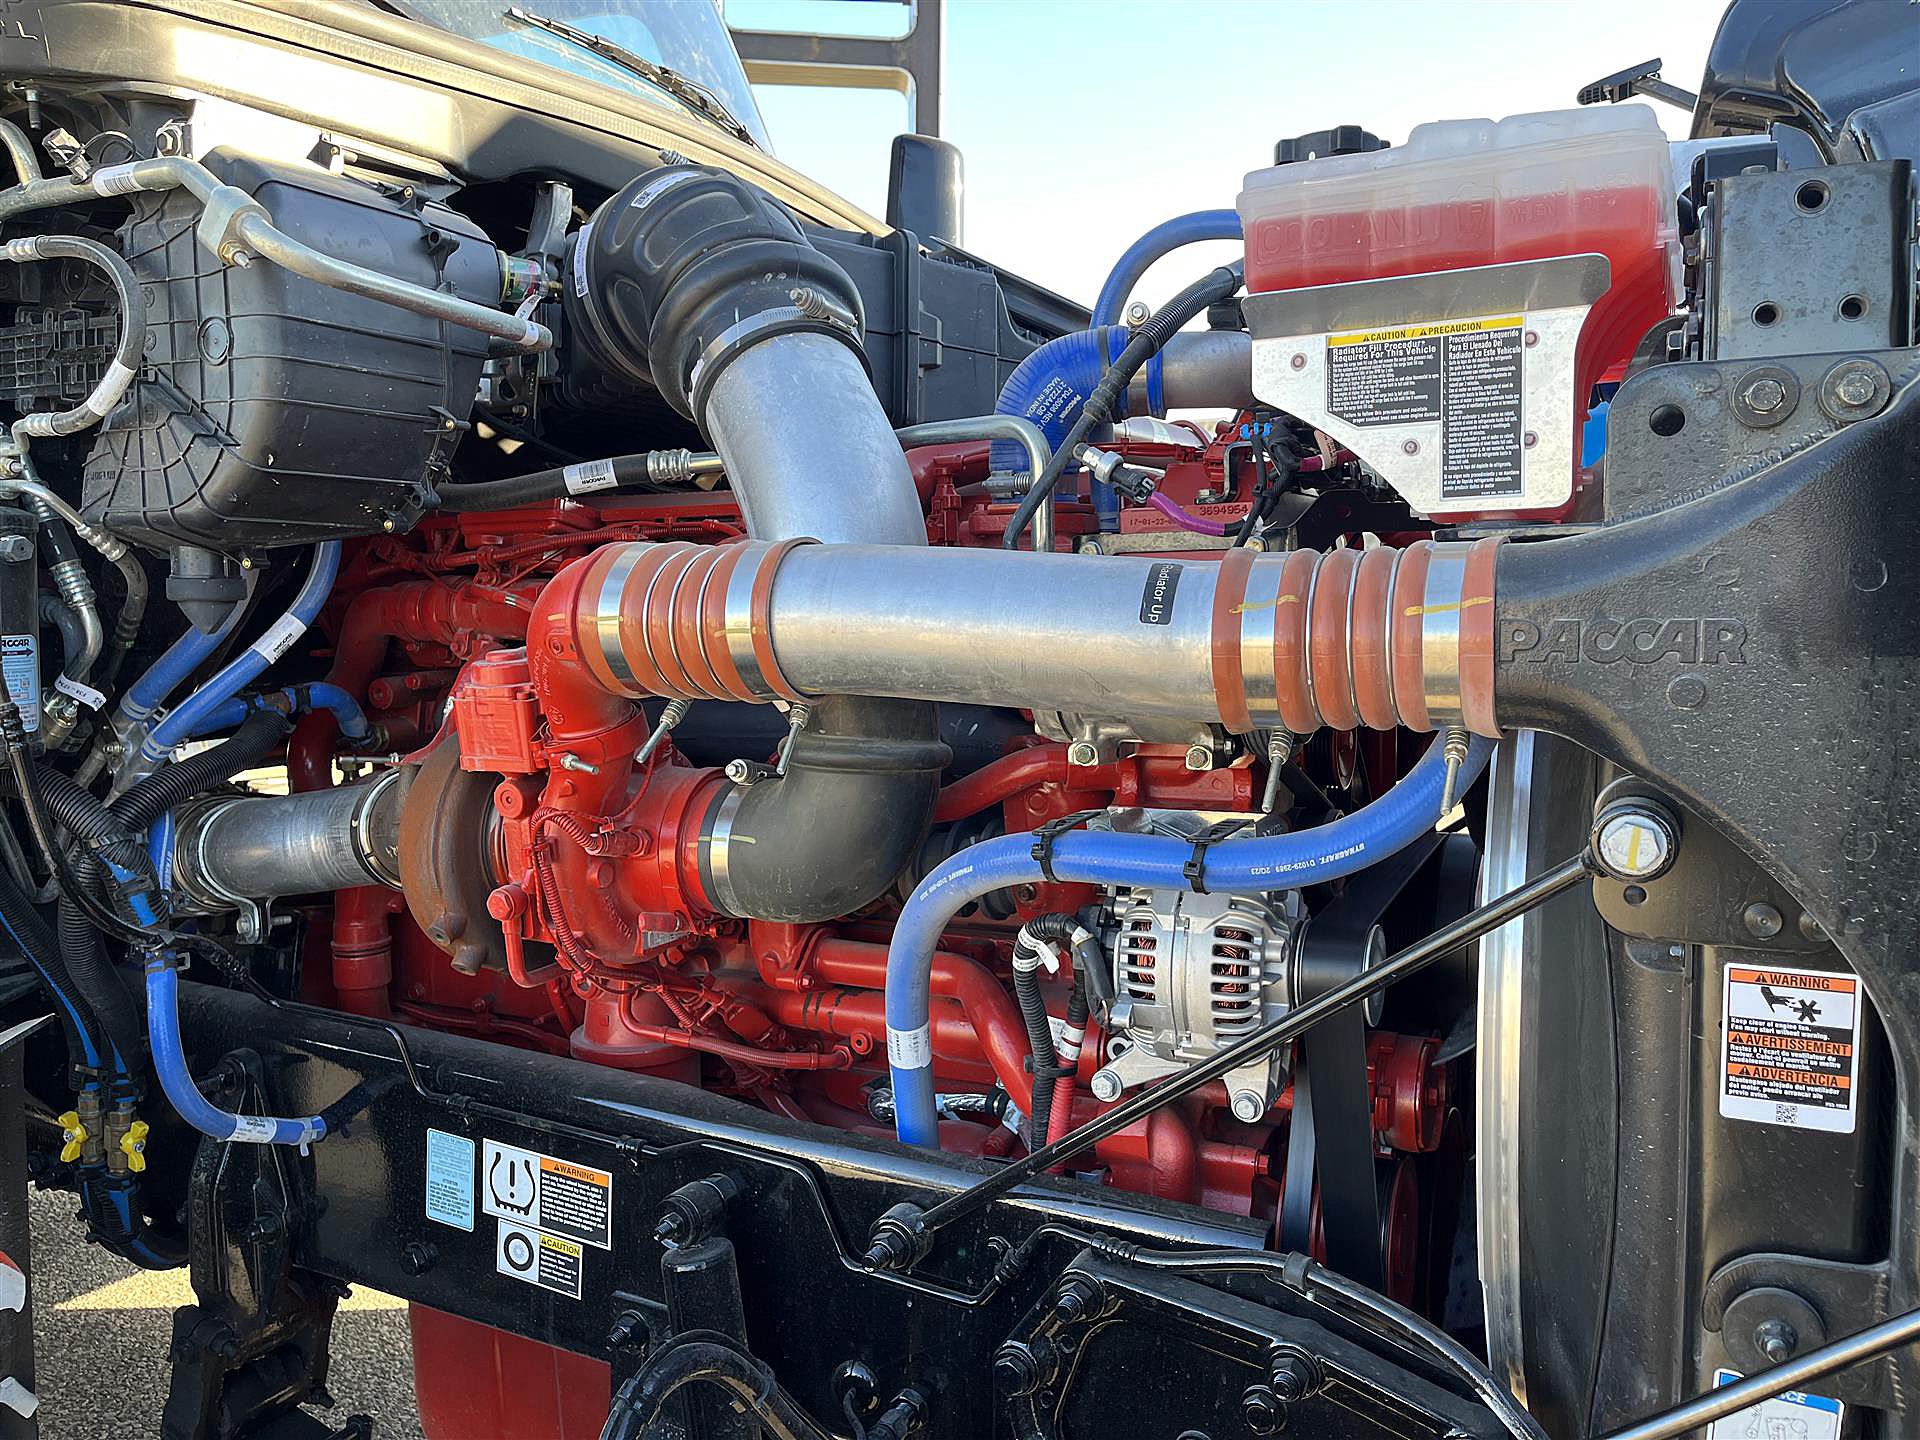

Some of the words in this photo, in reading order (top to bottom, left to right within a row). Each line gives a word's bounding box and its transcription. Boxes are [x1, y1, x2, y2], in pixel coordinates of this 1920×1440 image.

[1261, 205, 1433, 254] COOLANT
[1370, 330, 1406, 342] CAUTION
[1428, 322, 1482, 336] PRECAUCION
[1448, 333, 1489, 344] Procedimiento
[1490, 330, 1520, 340] Requerido
[1333, 346, 1366, 356] Radiator
[1369, 344, 1382, 352] Fill
[1448, 344, 1462, 352] Para
[1462, 342, 1469, 350] El
[1470, 340, 1492, 349] Llenado
[1492, 338, 1503, 348] Del
[1333, 352, 1369, 363] Required
[1387, 348, 1404, 358] This
[1406, 344, 1436, 354] Vehicle
[1448, 351, 1474, 360] Radiador
[1474, 350, 1482, 358] En
[1483, 348, 1496, 356] Este
[1043, 376, 1060, 395] MADE
[1024, 400, 1040, 418] INDIA
[1040, 412, 1053, 426] REV
[1154, 564, 1174, 602] Radiator
[1148, 604, 1164, 622] Up
[2, 638, 30, 648] ACCAR
[1499, 618, 1747, 664] PACCAR
[1770, 974, 1830, 990] WARNING
[1731, 1017, 1747, 1026] Keep
[1748, 1019, 1765, 1027] clear
[1775, 1022, 1797, 1030] engine
[1798, 1024, 1812, 1032] fan.
[1759, 1026, 1775, 1034] start
[1776, 1028, 1800, 1038] without
[1801, 1030, 1831, 1041] warning.
[1746, 1034, 1849, 1055] AVERTISSEMENT
[1753, 1068, 1838, 1086] ADVERTENCIA
[1728, 1088, 1749, 1096] previo
[1750, 1091, 1770, 1100] aviso.
[560, 1165, 595, 1181] WARNING
[547, 1238, 580, 1255] CAUTION
